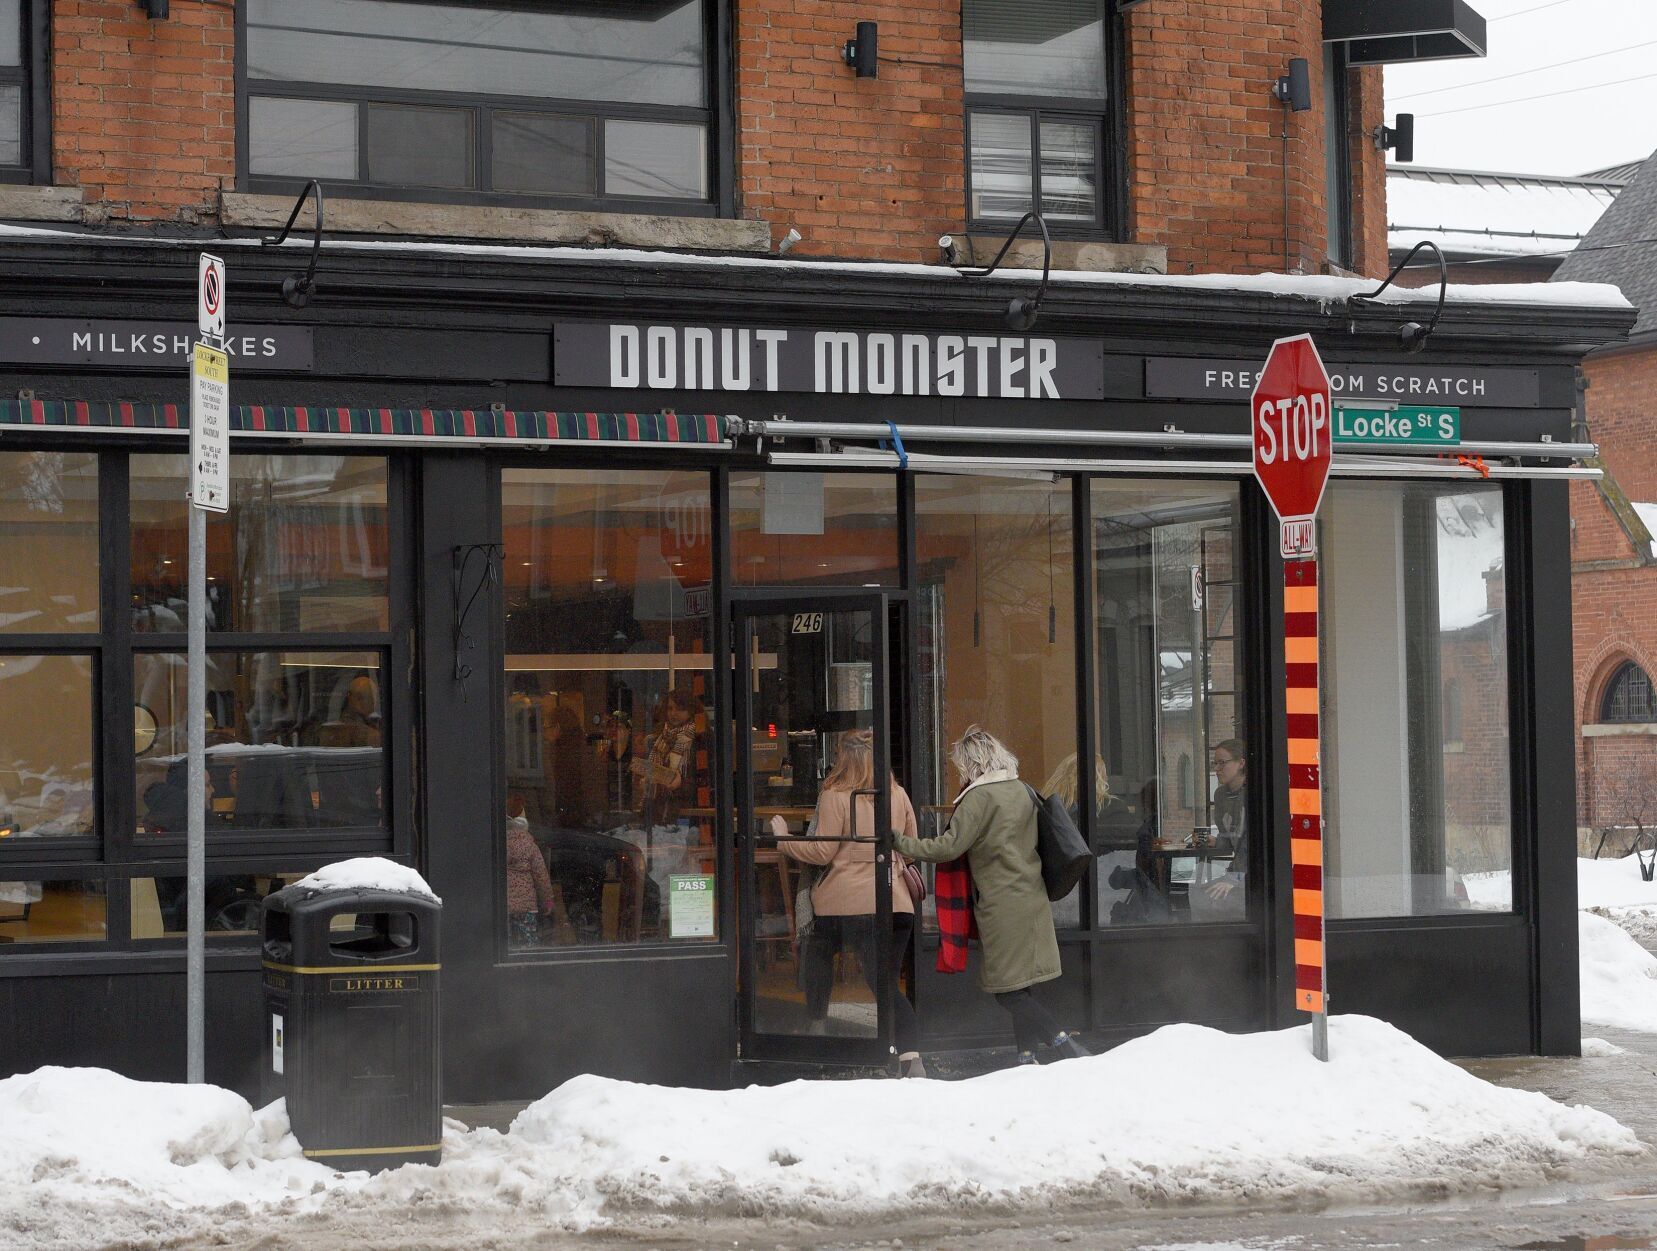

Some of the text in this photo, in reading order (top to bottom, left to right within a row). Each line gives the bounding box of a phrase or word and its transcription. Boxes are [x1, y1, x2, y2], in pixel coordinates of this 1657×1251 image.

[609, 324, 1061, 399] DONUT MONSTER
[1205, 370, 1487, 396] FRE OM SCRATCH
[1259, 392, 1326, 465] STOP
[1338, 411, 1455, 439] Locke St S
[1283, 524, 1313, 550] ALL-WAY
[794, 613, 822, 632] 246
[678, 881, 706, 890] PASS
[346, 979, 404, 991] LITTER
